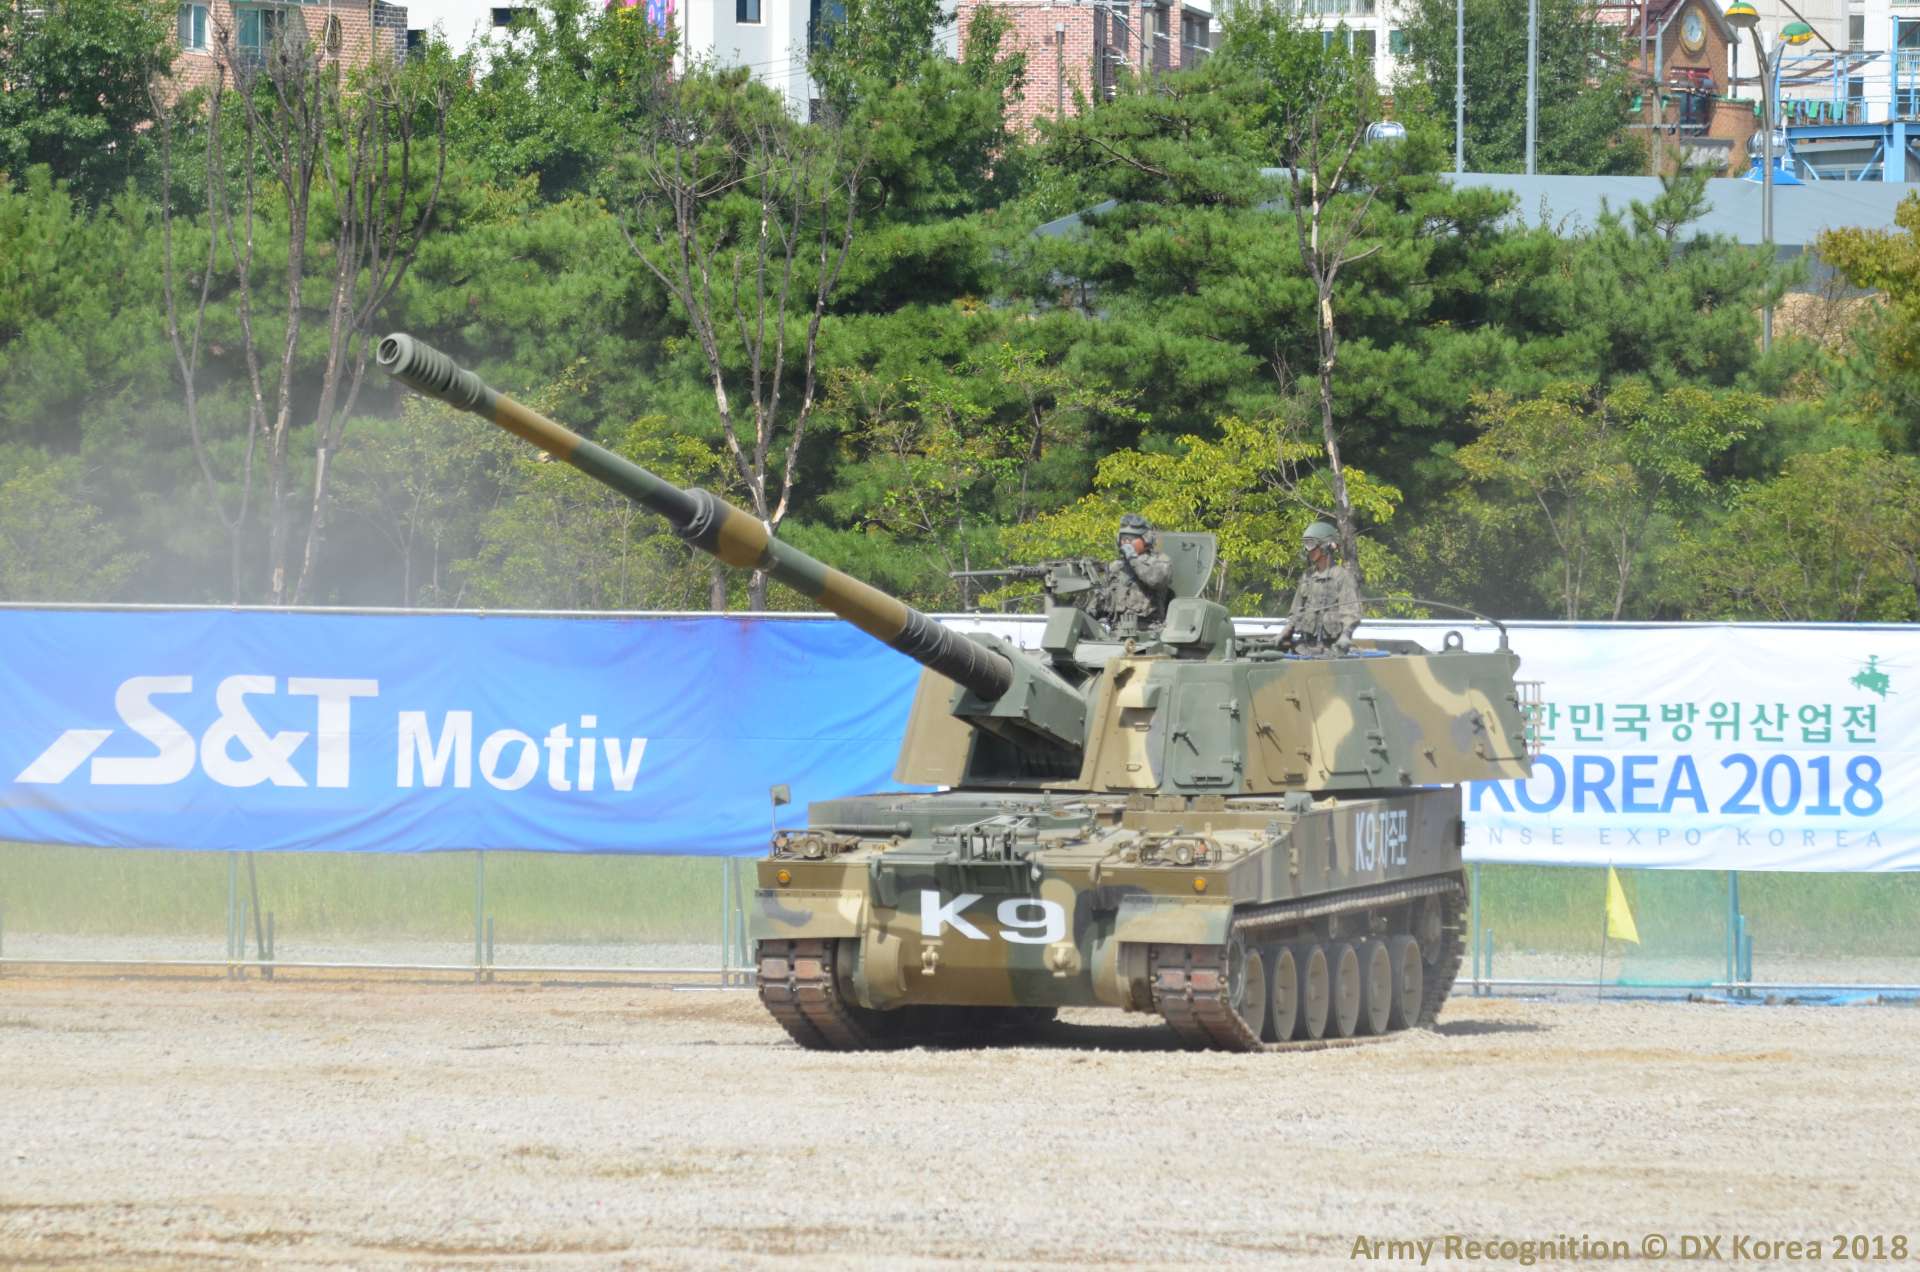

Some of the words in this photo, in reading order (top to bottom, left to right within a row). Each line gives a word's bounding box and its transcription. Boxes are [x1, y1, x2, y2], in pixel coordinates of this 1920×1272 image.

[14, 674, 379, 788] S&T
[396, 711, 648, 792] Motiv
[1469, 753, 1709, 814] KOREA
[1720, 753, 1884, 817] 2018
[1600, 827, 1702, 847] EXPO
[1737, 827, 1883, 848] KOREA
[921, 889, 1067, 944] K9
